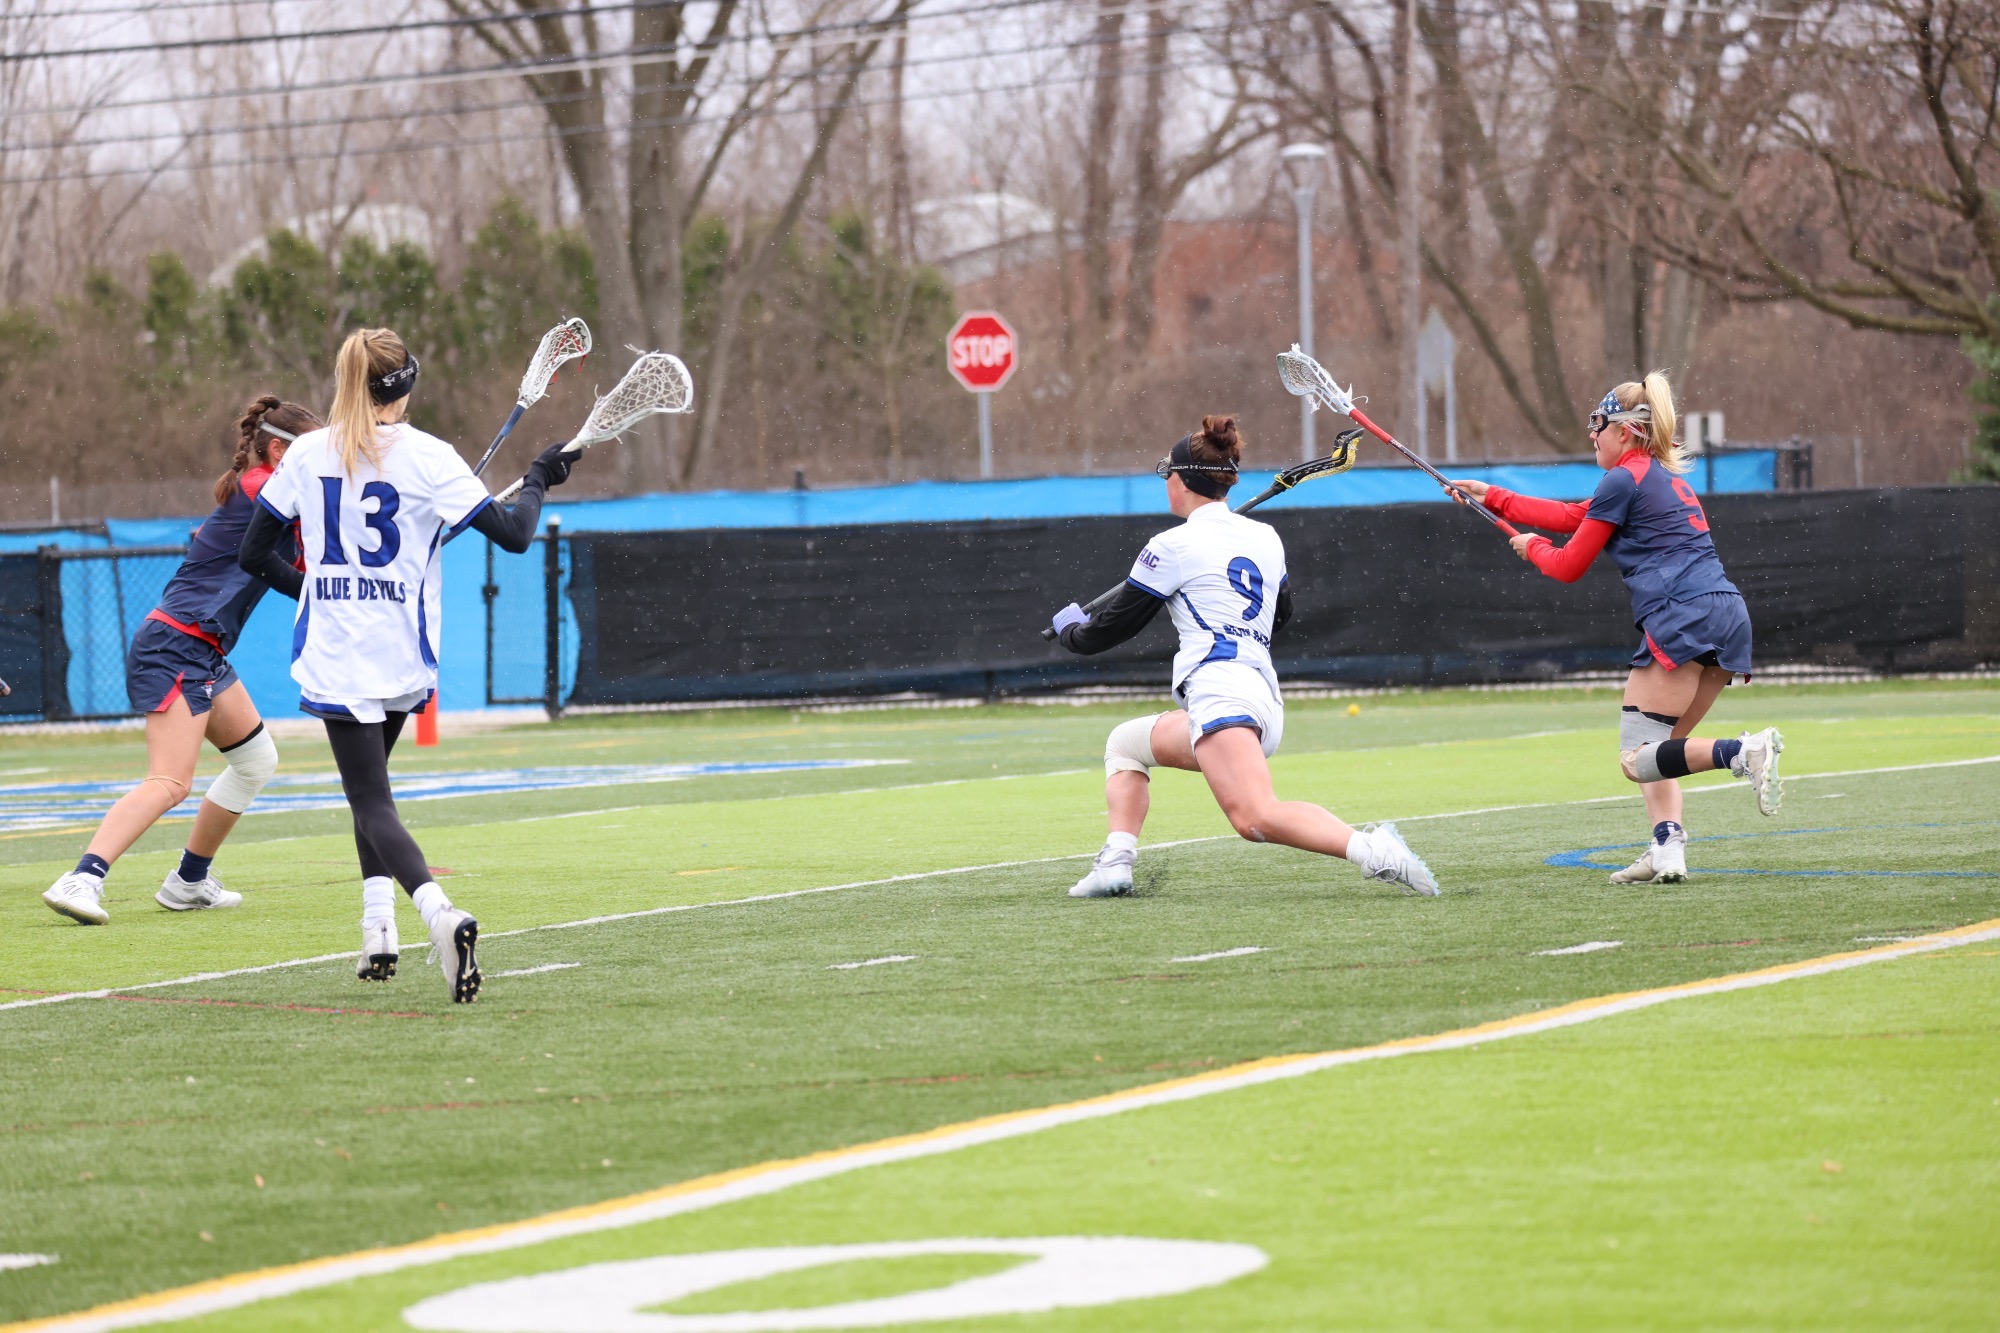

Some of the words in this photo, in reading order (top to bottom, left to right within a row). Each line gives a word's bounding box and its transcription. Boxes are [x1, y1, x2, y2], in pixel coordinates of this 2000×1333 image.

[953, 334, 1010, 368] STOP
[318, 476, 401, 568] 13
[1671, 477, 1710, 532] 9
[1137, 547, 1160, 568] HAC
[315, 577, 352, 600] BLUE
[357, 577, 407, 604] DEVILS
[1226, 556, 1264, 622] 9
